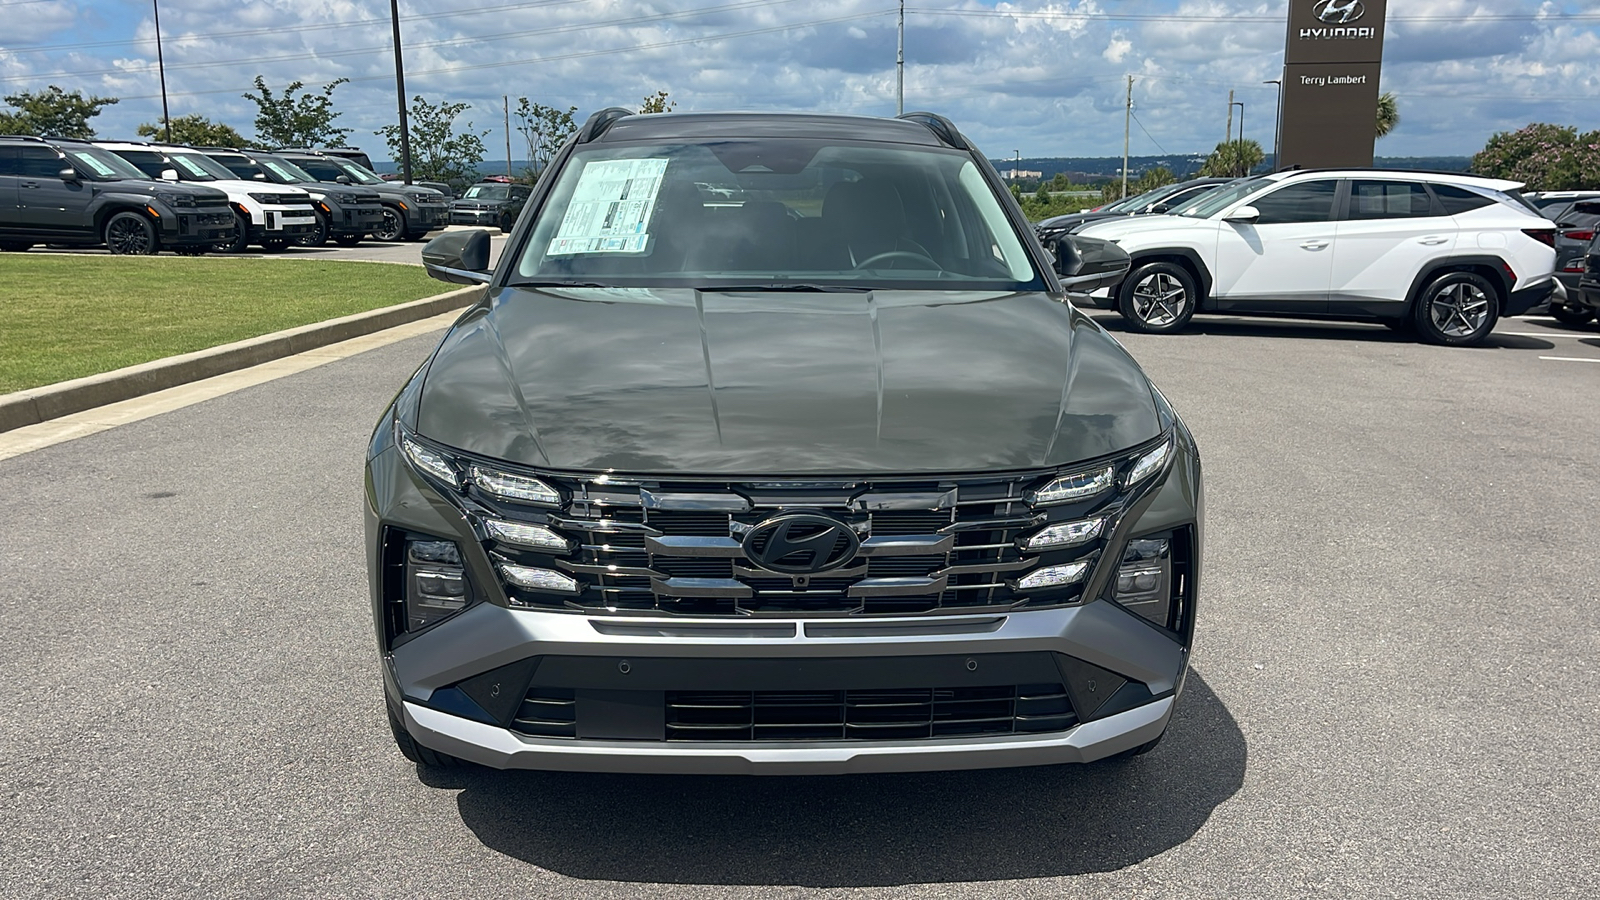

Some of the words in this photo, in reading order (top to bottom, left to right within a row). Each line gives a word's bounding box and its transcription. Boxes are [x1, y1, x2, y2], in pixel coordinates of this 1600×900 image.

[1299, 27, 1376, 40] HYUNDAI
[1300, 75, 1325, 87] Terry
[1327, 74, 1367, 85] Lambert
